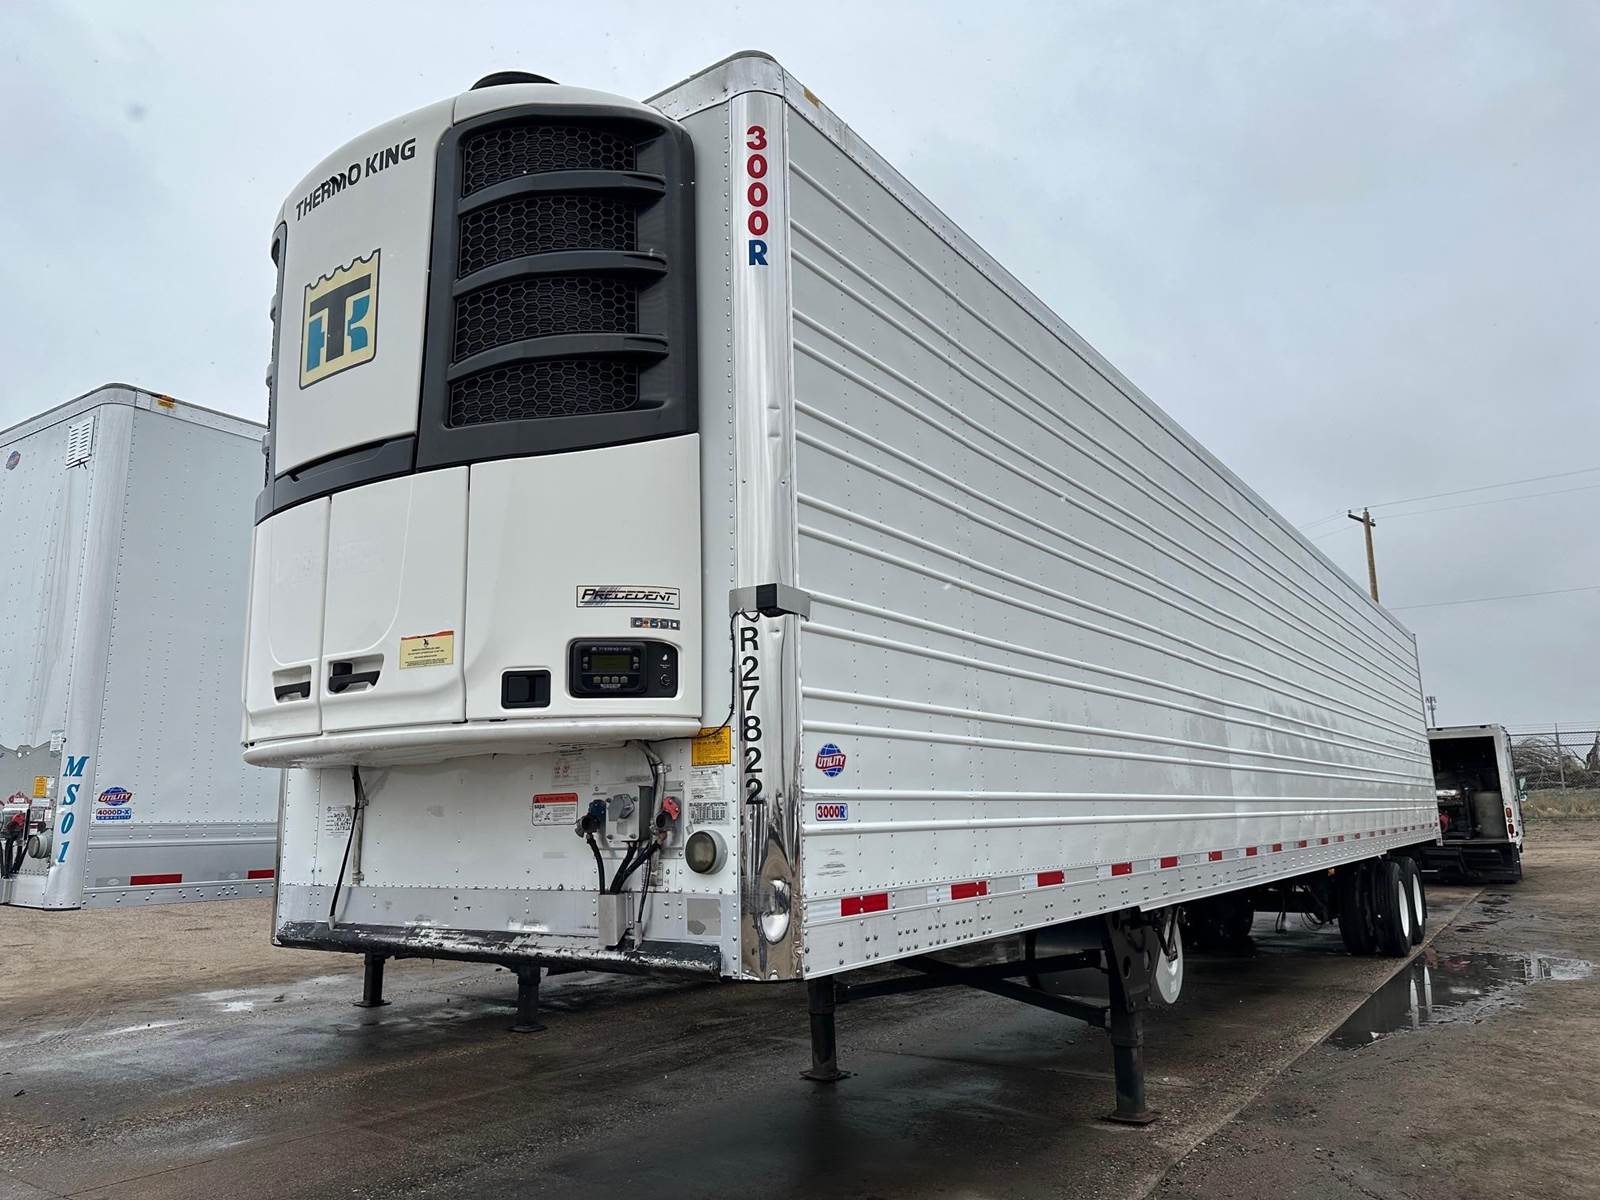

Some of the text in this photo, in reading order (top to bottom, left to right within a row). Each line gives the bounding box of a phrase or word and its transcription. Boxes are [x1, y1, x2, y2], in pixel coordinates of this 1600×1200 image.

[296, 138, 416, 221] THERMO KING
[746, 125, 769, 266] 3000R
[581, 589, 677, 602] PRECEDENT
[817, 755, 846, 768] UTILITY
[100, 792, 131, 802] UTILITY
[57, 755, 90, 863] MS01
[817, 805, 846, 818] 3000R
